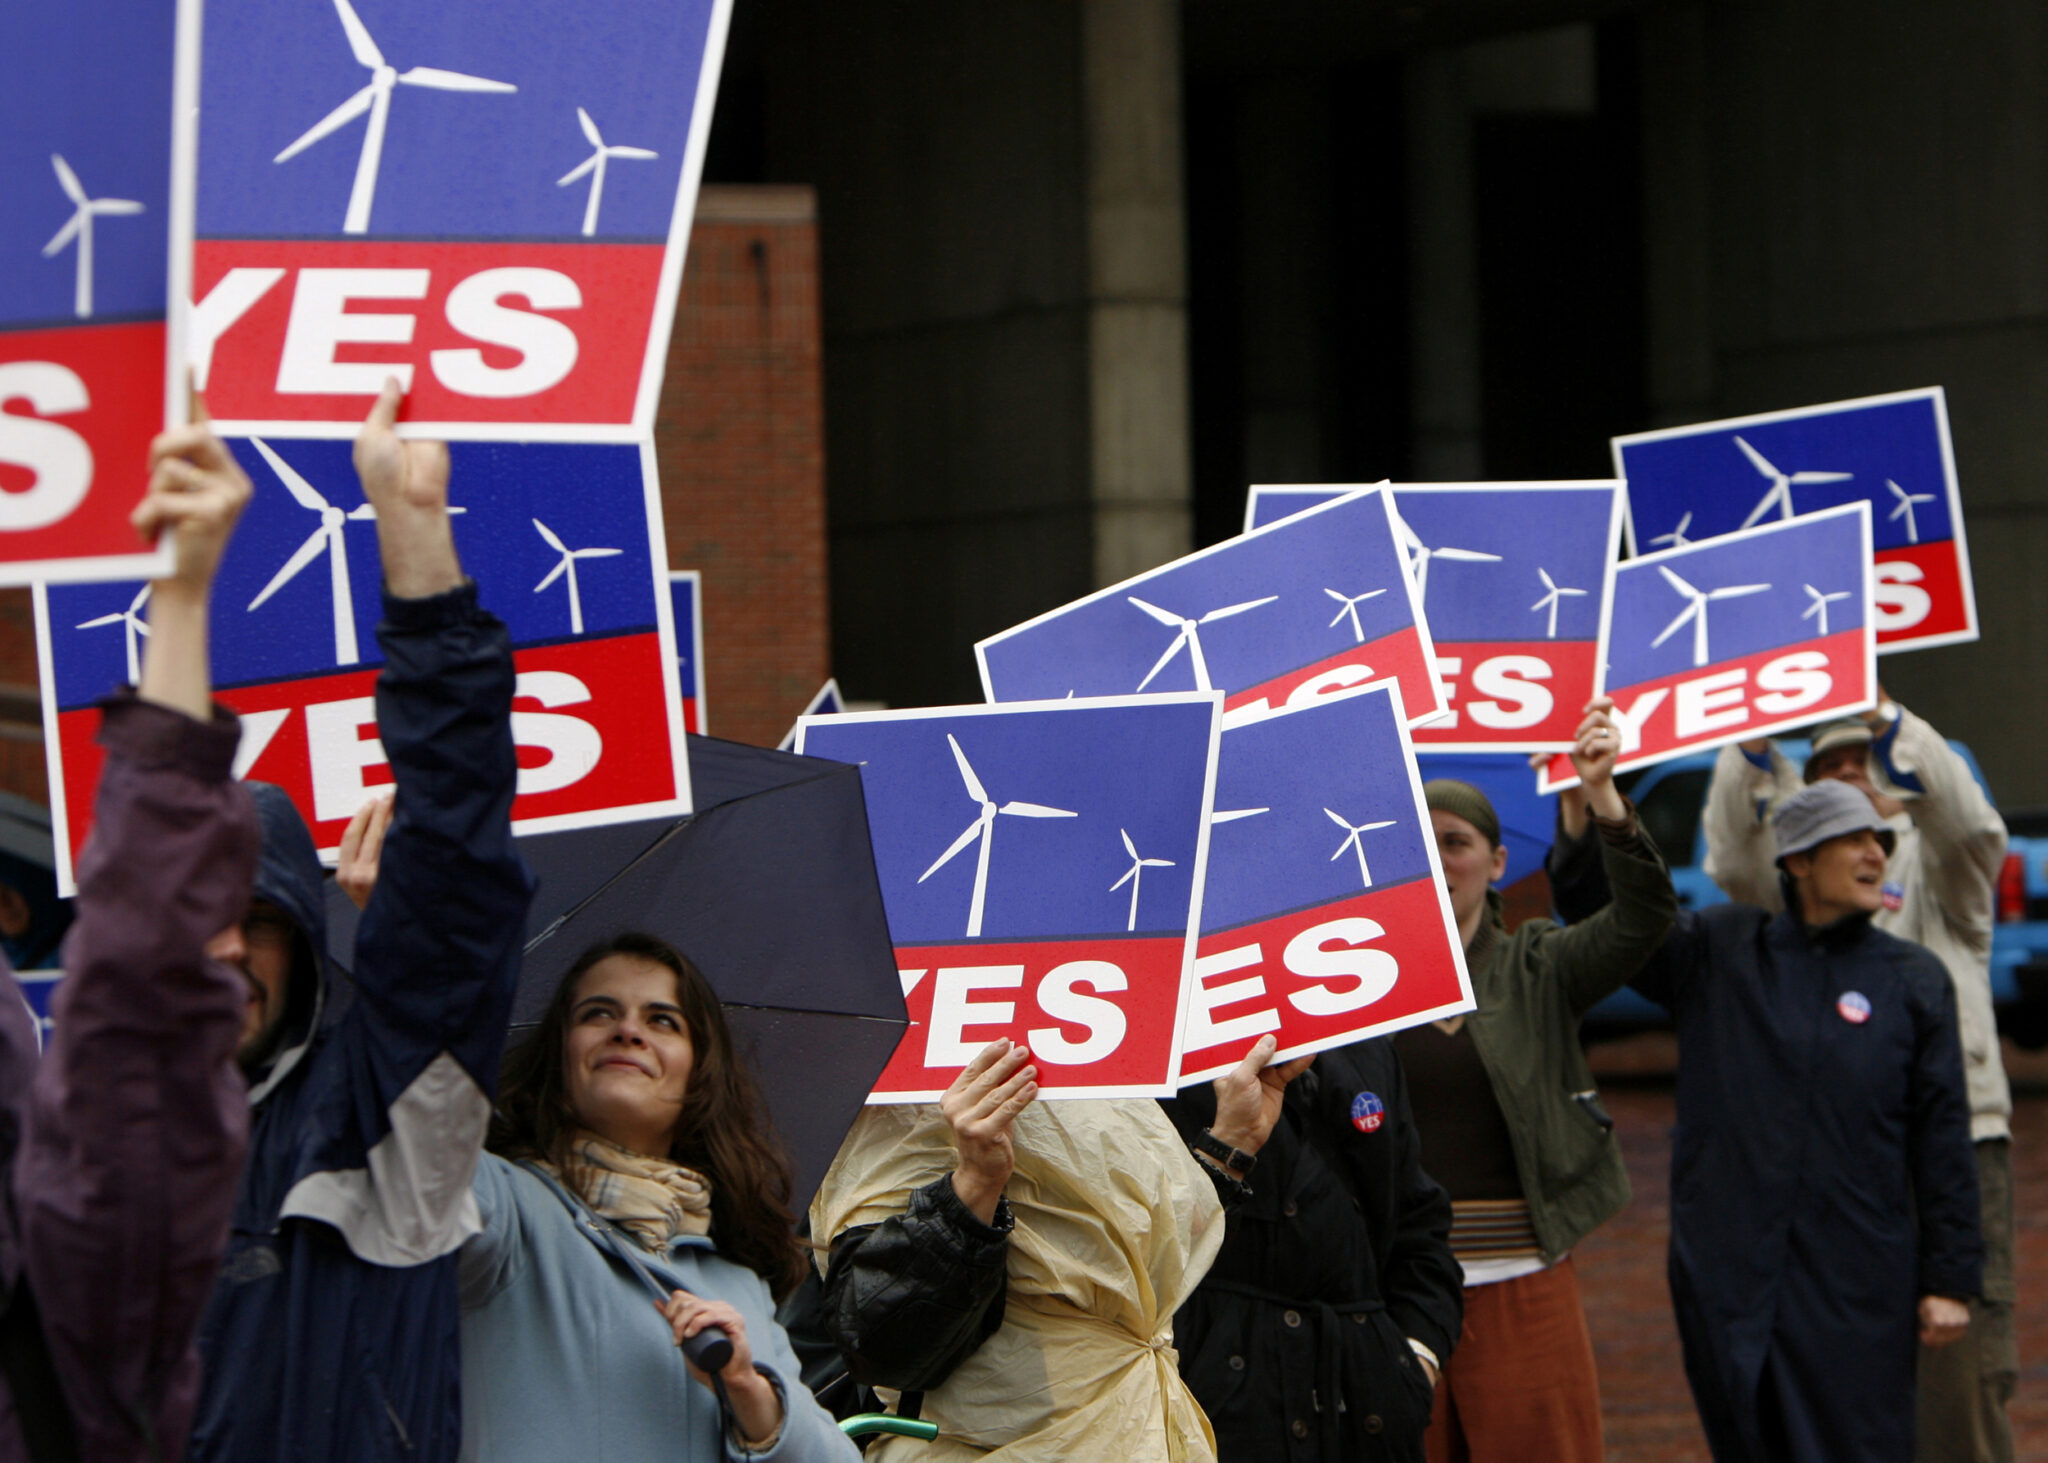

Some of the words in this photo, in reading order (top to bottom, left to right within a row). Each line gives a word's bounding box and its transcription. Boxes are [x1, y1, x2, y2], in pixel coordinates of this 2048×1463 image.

[1610, 651, 1832, 752] YES
[898, 961, 1128, 1068] ES
[1184, 917, 1399, 1054] ES
[1359, 1115, 1380, 1130] YES
